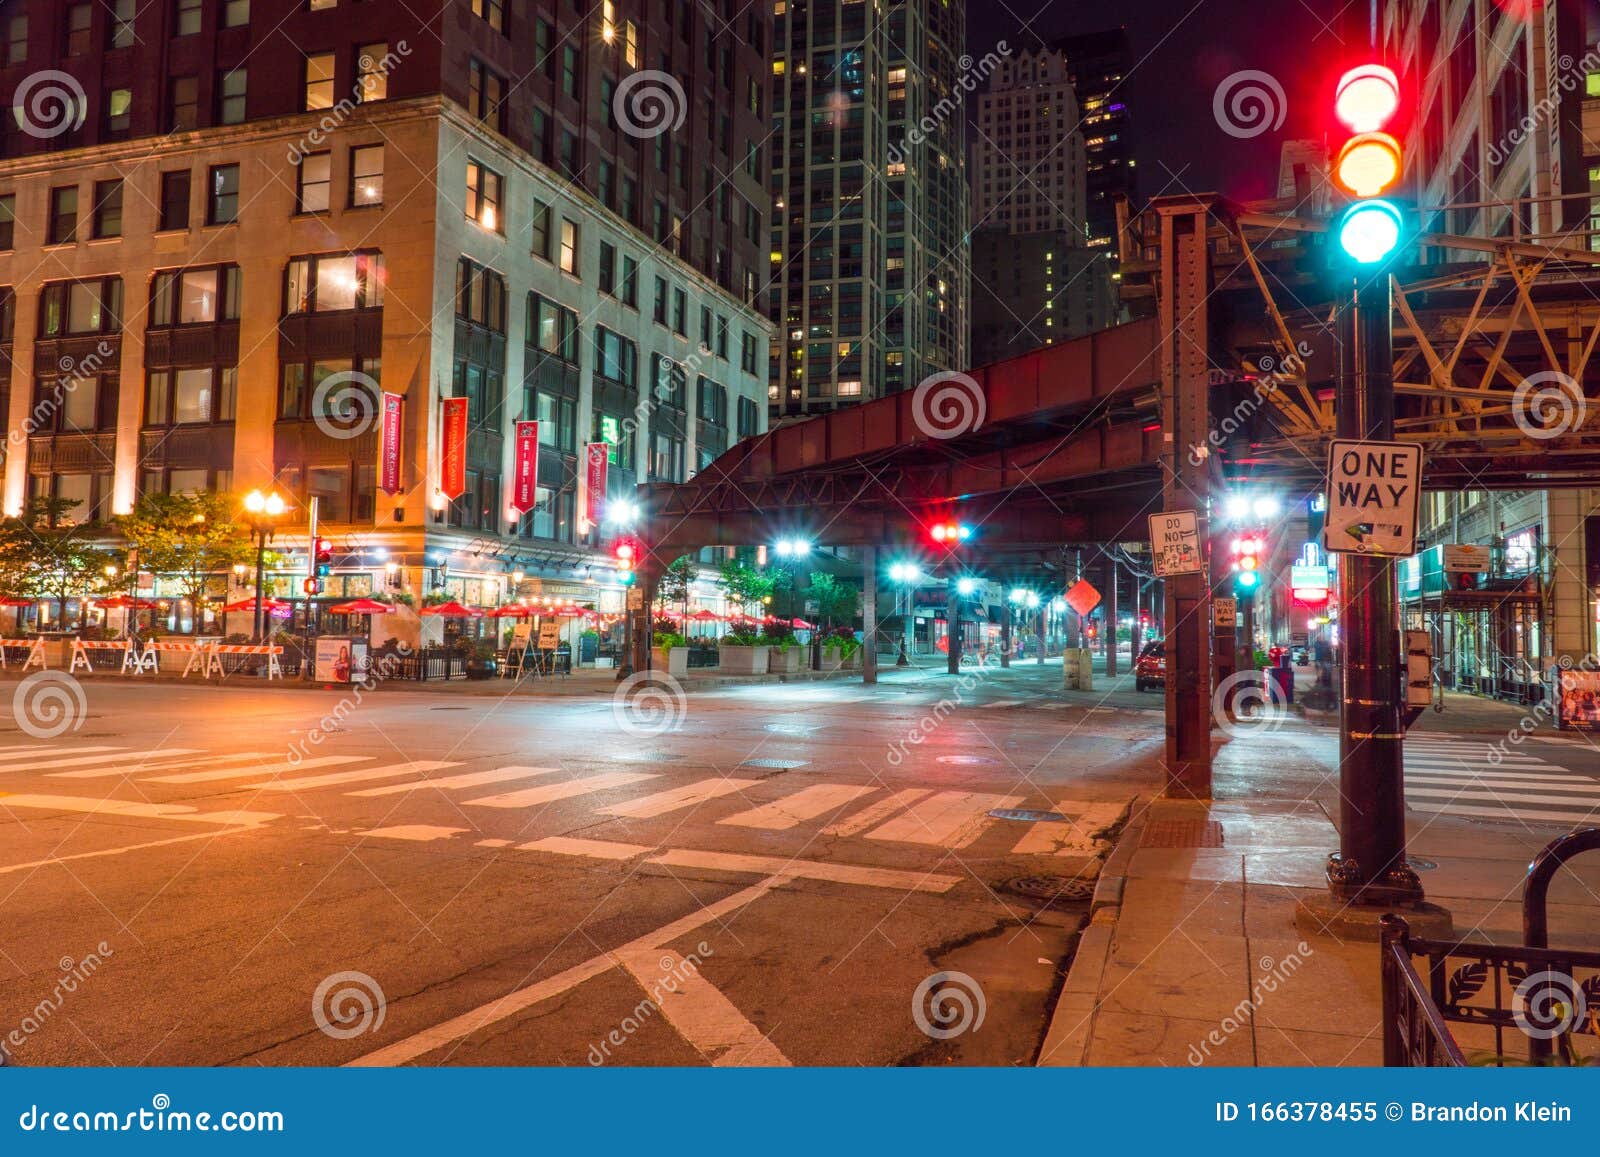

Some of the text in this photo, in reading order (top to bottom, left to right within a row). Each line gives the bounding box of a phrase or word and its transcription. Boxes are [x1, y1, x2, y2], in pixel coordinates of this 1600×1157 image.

[1341, 451, 1408, 478] ONE
[1338, 481, 1408, 509] WAY
[1167, 519, 1180, 529] DO
[1164, 530, 1185, 542] NOT
